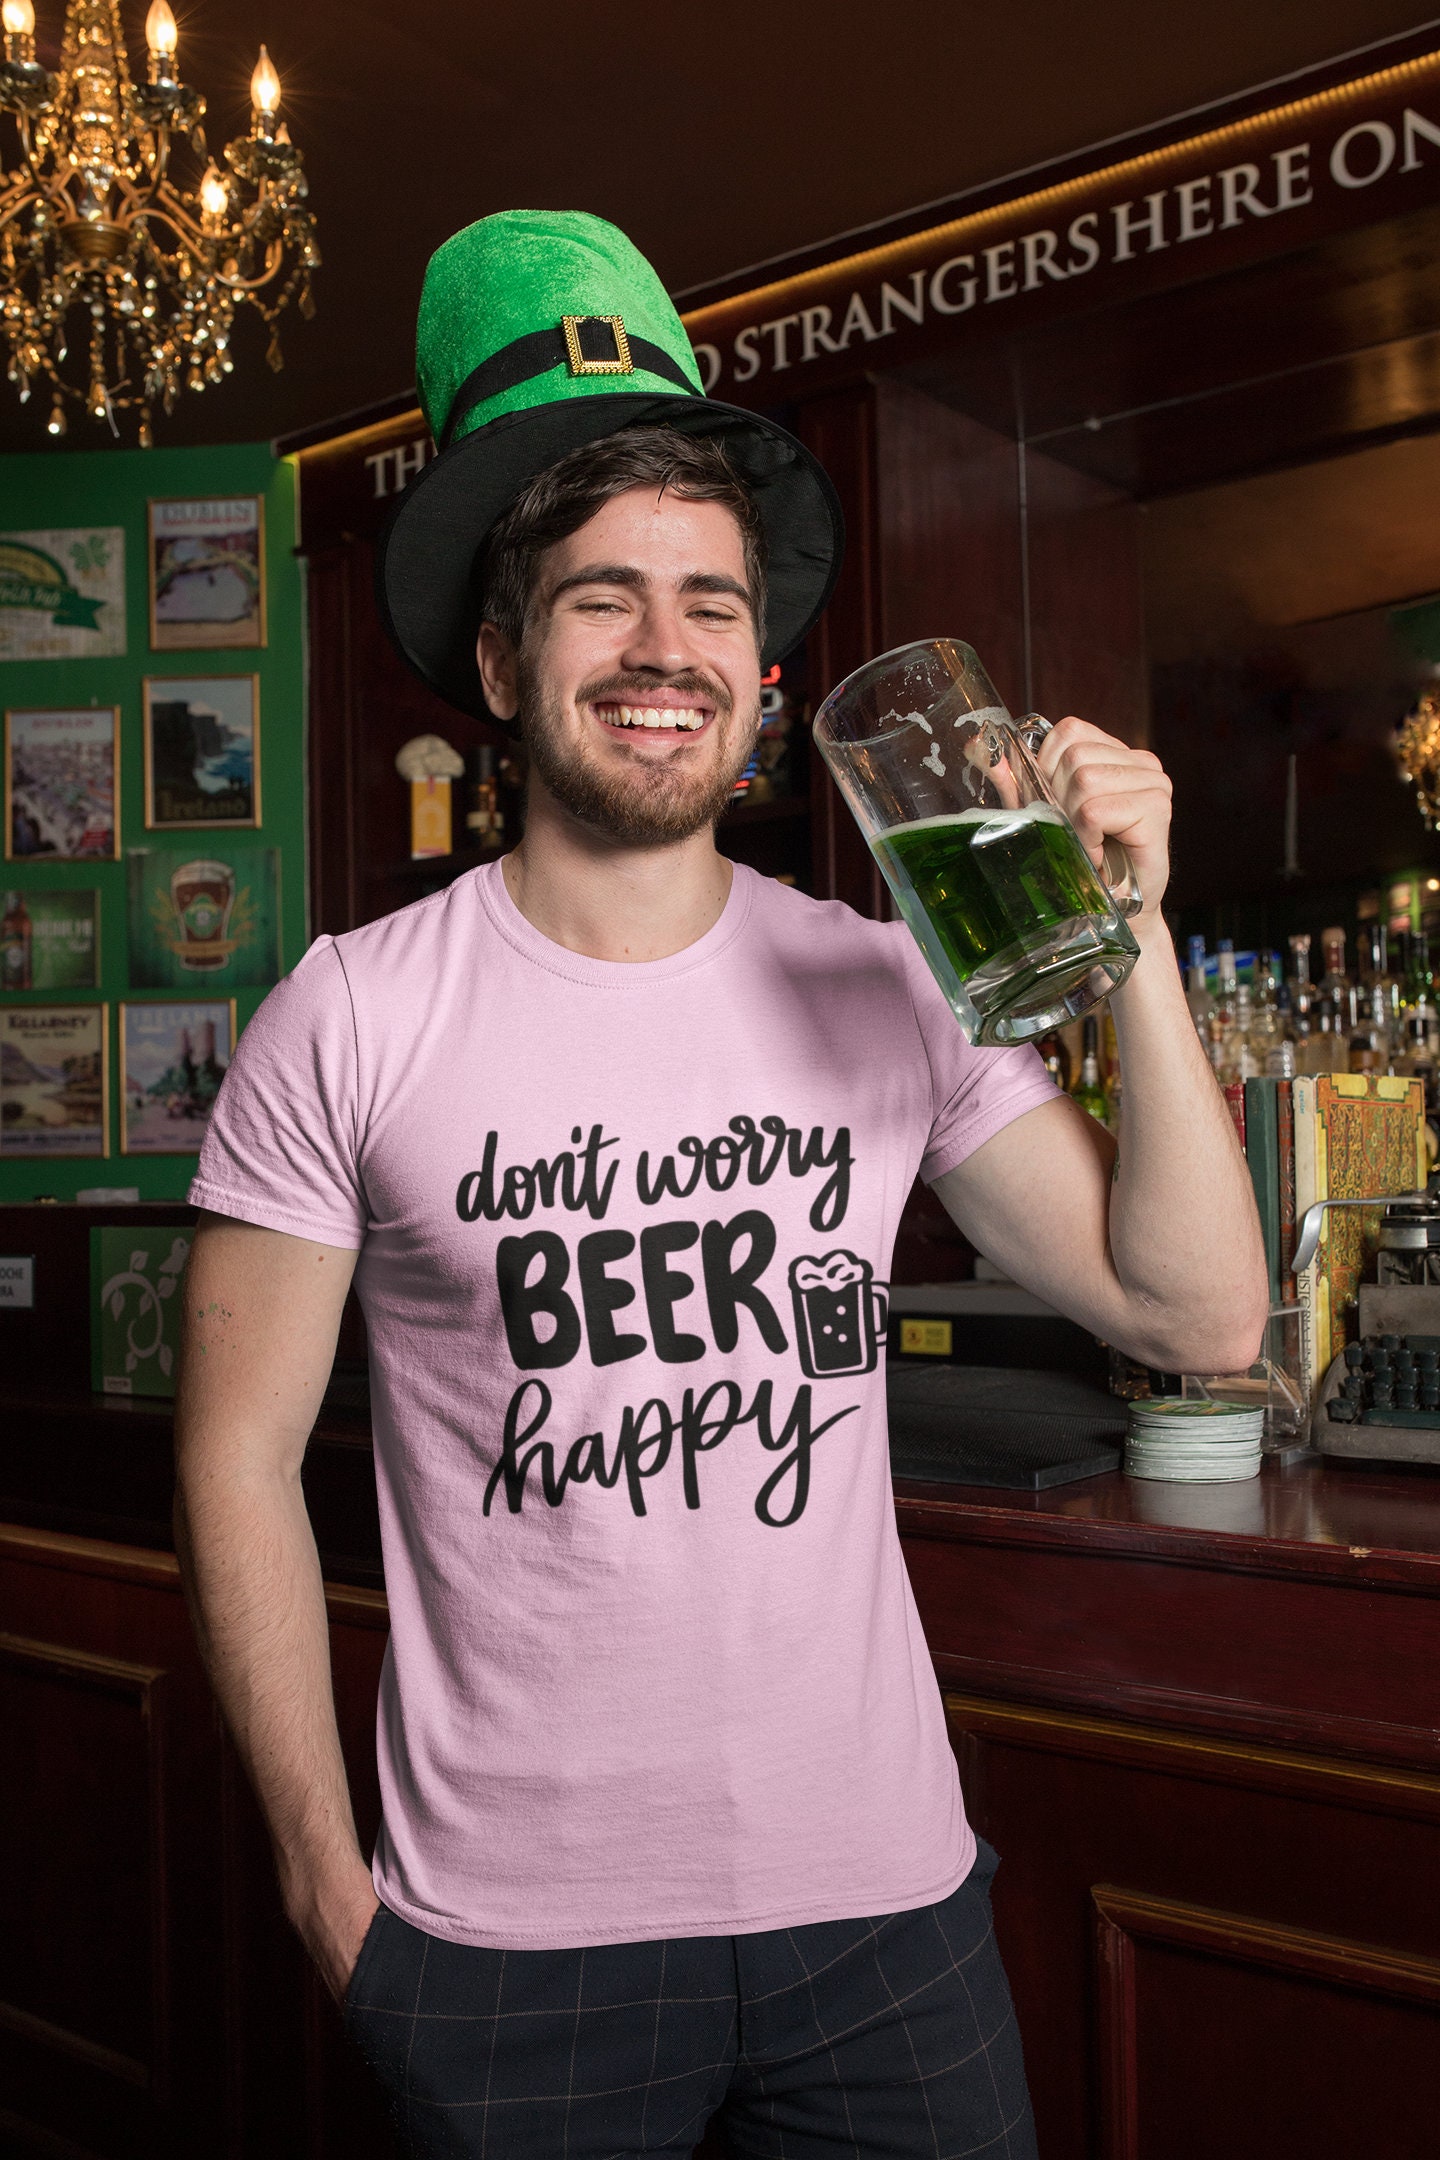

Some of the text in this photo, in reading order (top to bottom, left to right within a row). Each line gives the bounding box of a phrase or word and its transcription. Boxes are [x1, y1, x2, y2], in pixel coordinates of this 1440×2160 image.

[364, 436, 439, 499] TH
[733, 212, 1101, 382] STRANGERS
[1110, 142, 1313, 263] HERE
[636, 1115, 856, 1232] worry
[496, 1209, 789, 1371] BEER
[482, 1378, 861, 1528] happy
